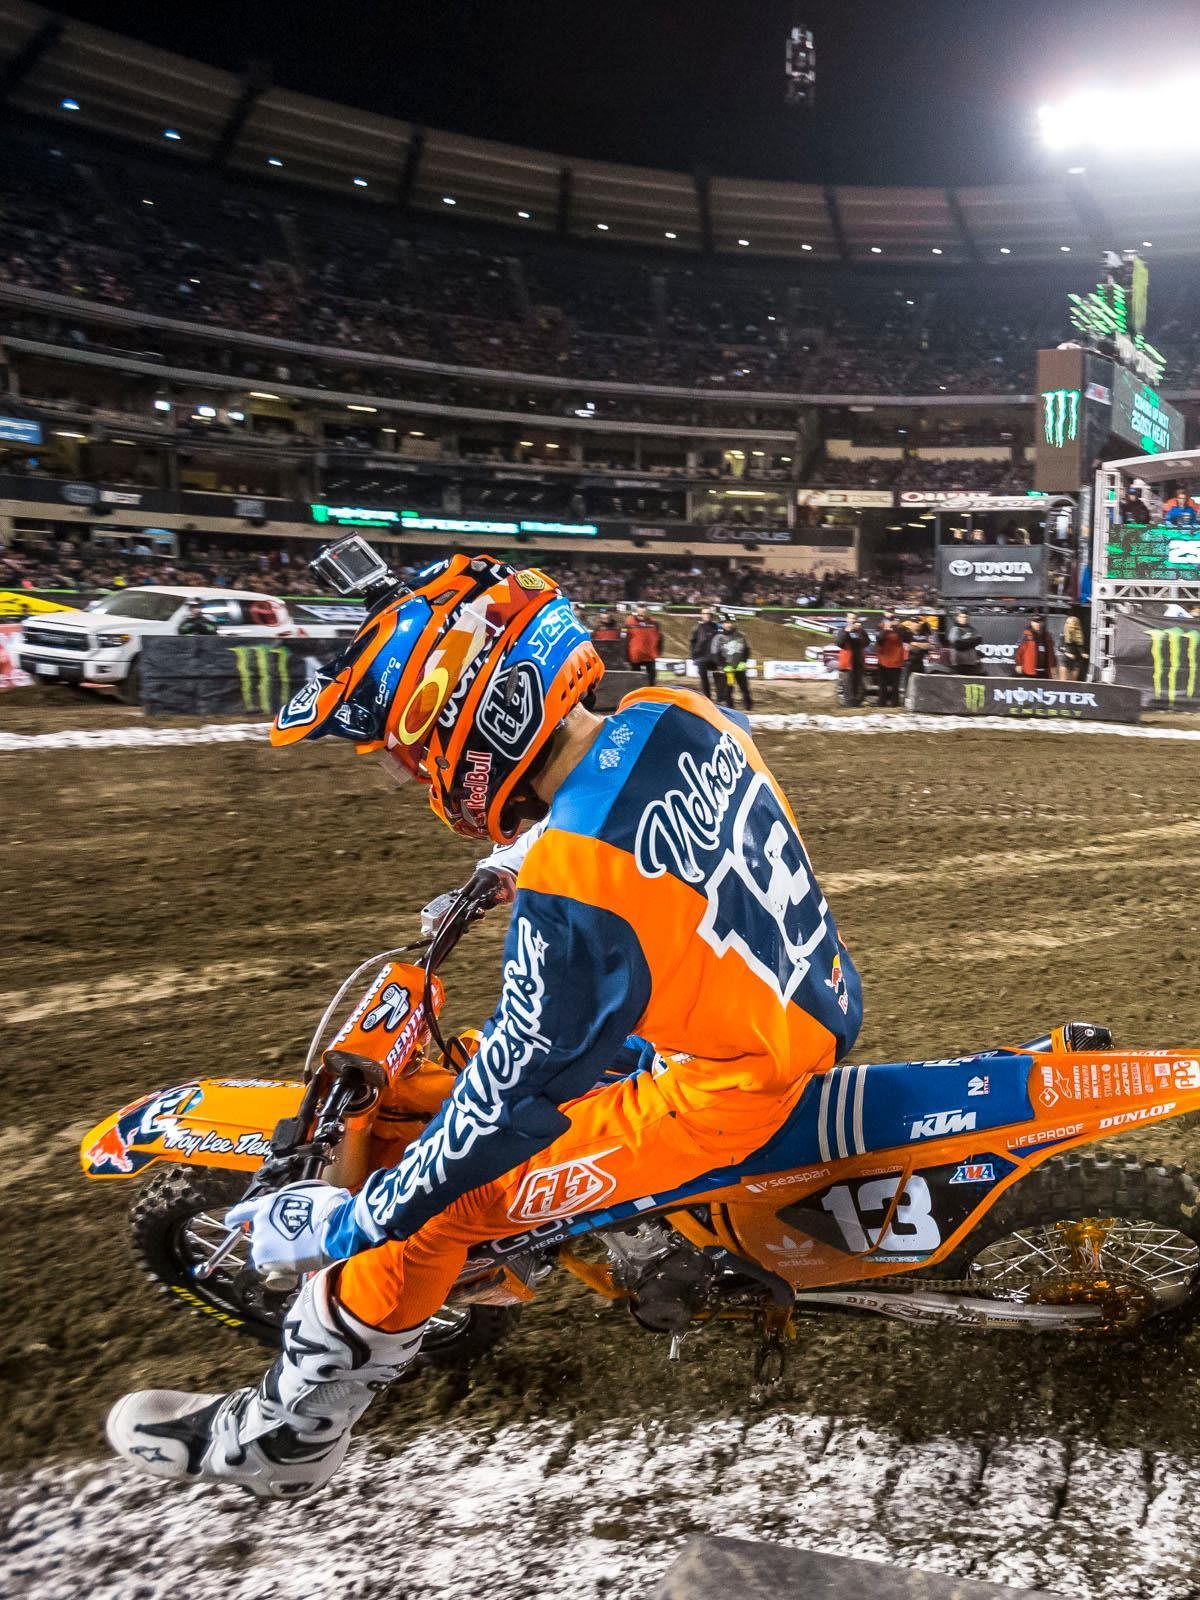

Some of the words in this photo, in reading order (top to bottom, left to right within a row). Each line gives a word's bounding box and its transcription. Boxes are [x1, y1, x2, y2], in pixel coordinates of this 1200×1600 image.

[1151, 423, 1167, 448] HEAT
[972, 561, 1034, 575] TOYOTA
[374, 656, 402, 706] GoPro
[993, 686, 1099, 707] MONSTER
[1008, 707, 1083, 718] ENERGY
[634, 729, 749, 883] Nelson
[910, 1109, 977, 1140] KTM
[1098, 1102, 1178, 1130] DUNLOP
[199, 1131, 233, 1152] Lee
[1006, 1123, 1085, 1149] LIFEPROOF
[767, 1167, 831, 1188] seaspan
[957, 1164, 994, 1181] AMA
[821, 1174, 942, 1254] 13
[170, 1284, 247, 1328] DUNLOP
